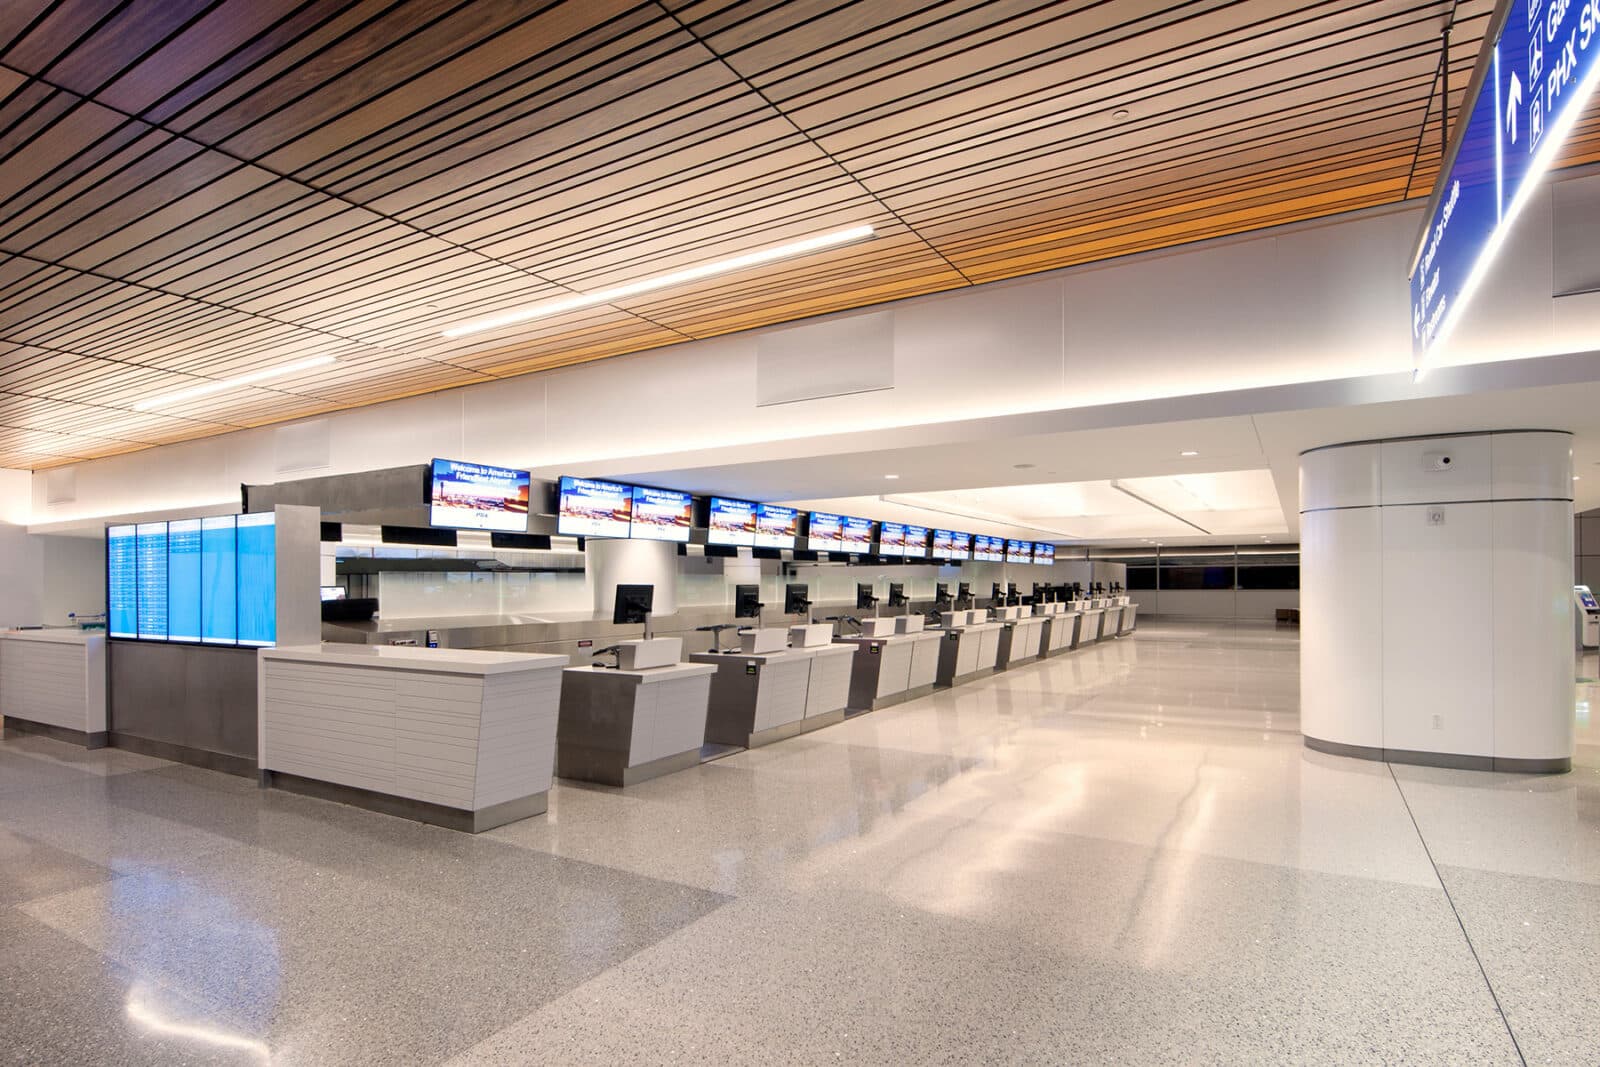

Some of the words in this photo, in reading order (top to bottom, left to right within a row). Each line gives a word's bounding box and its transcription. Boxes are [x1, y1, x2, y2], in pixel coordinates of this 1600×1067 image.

[1547, 0, 1570, 42] Ga
[1547, 27, 1577, 112] PHX
[451, 462, 480, 474] Welcome
[488, 468, 517, 479] America's
